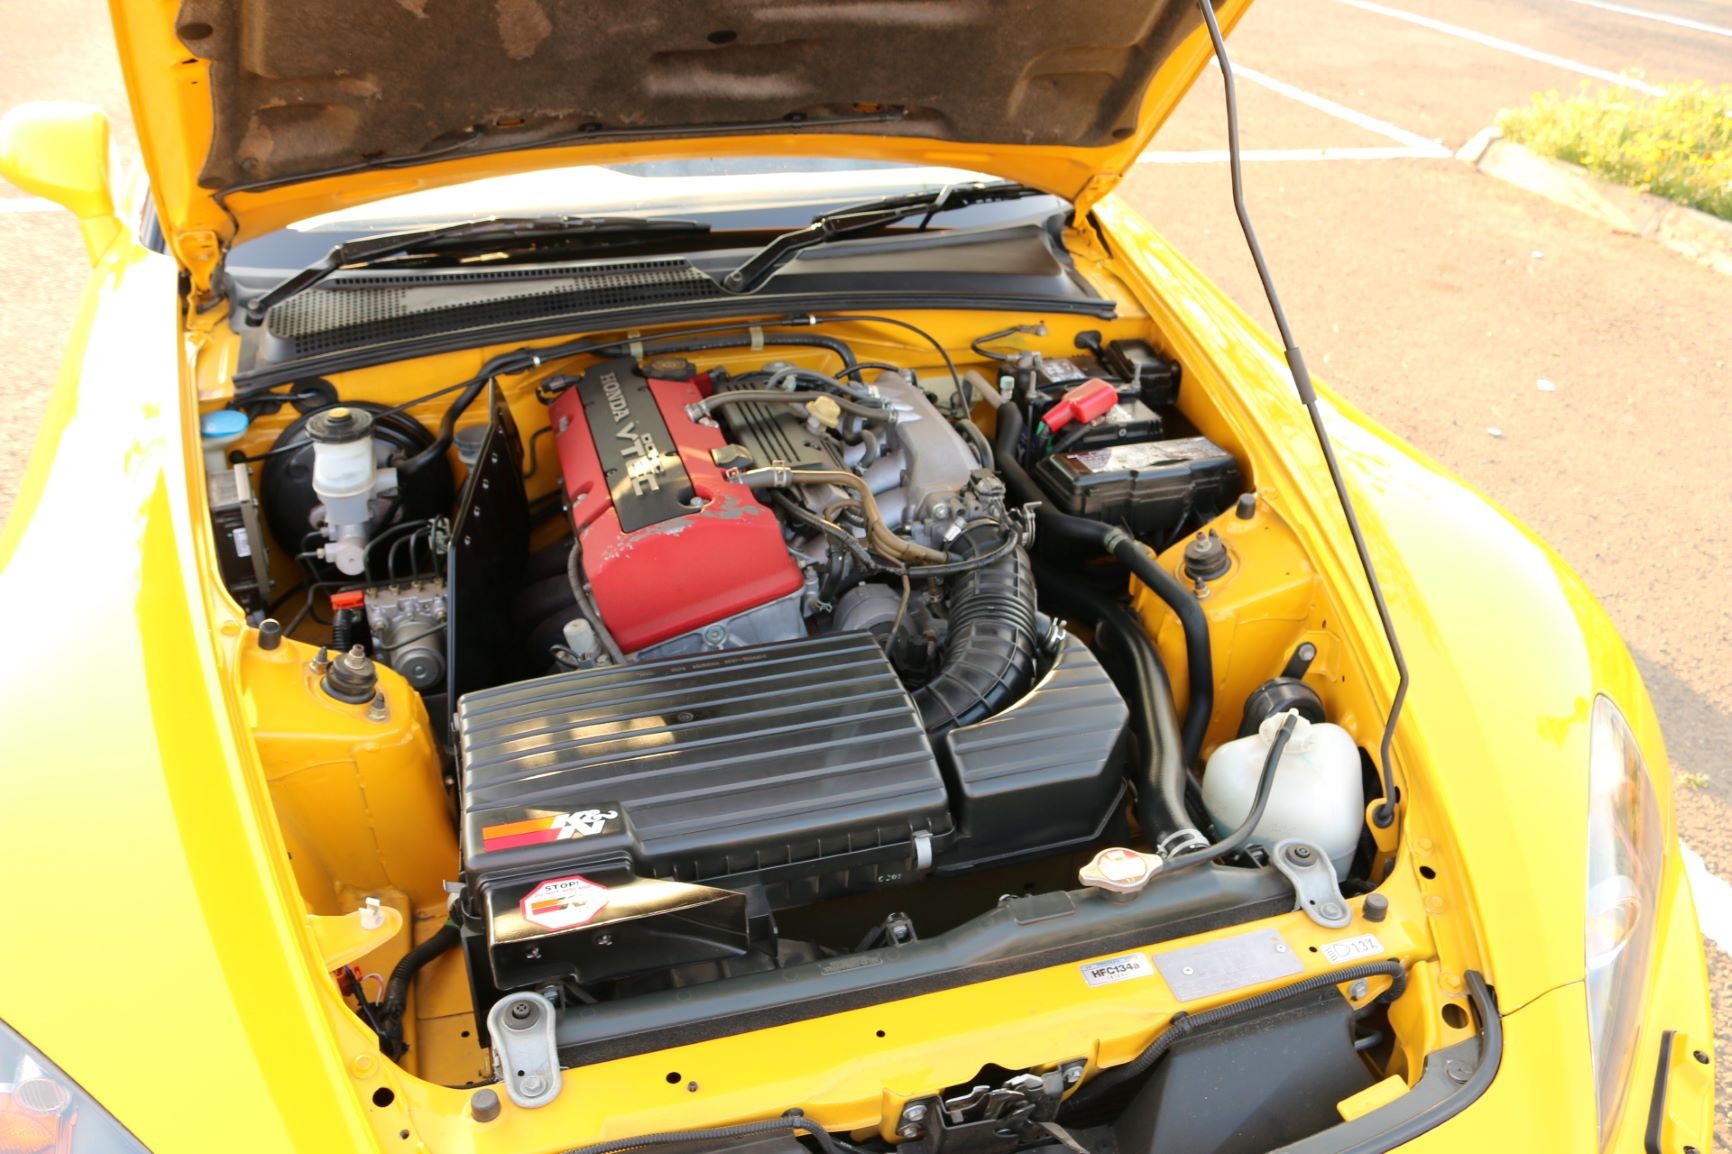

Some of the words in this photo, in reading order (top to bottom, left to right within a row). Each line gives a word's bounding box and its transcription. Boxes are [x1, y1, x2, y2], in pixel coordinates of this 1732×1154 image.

[600, 372, 629, 421] HONDA
[616, 422, 659, 496] VTEC
[551, 808, 619, 841] K&N
[544, 880, 580, 892] STOP!
[1091, 962, 1141, 979] HFC134a
